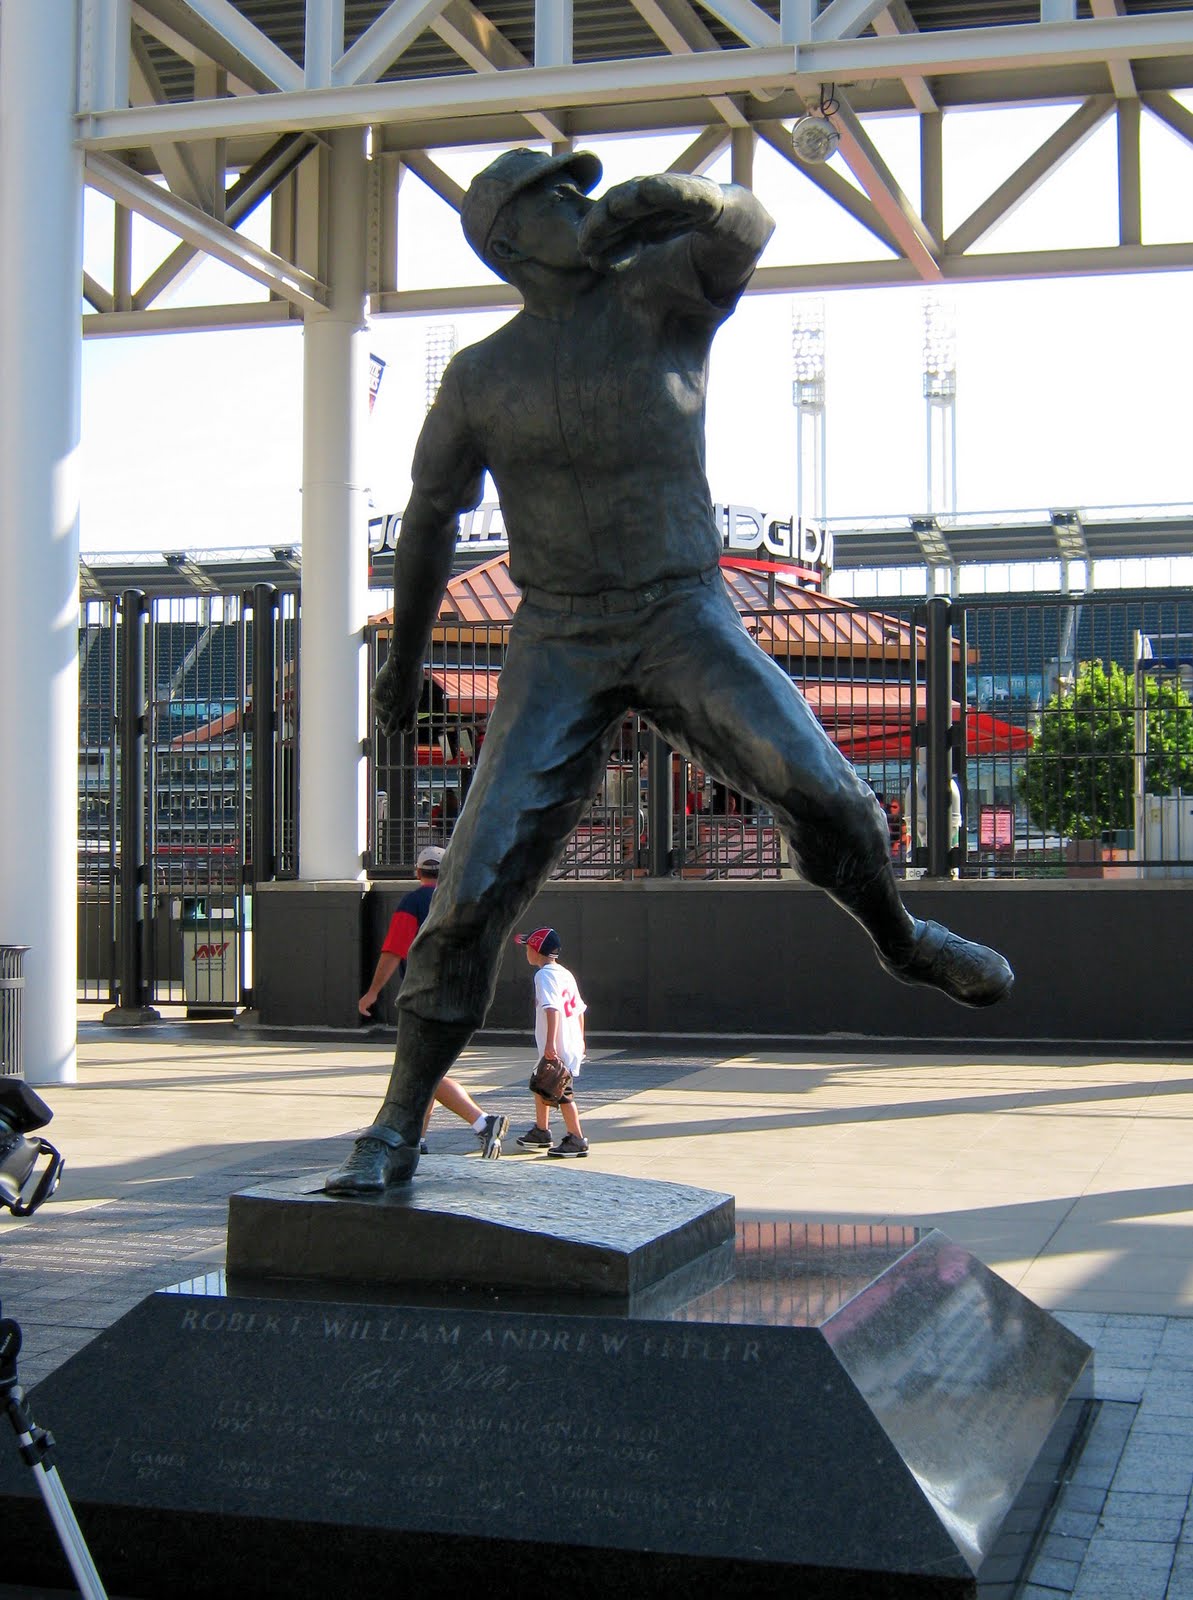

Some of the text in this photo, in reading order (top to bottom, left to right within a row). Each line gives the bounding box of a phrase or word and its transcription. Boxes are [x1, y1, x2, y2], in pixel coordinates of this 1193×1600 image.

[713, 503, 822, 563] IDGID
[181, 1309, 311, 1336] ROBERT
[322, 1311, 462, 1344] WILLIAM
[474, 1326, 629, 1355] ANDREW
